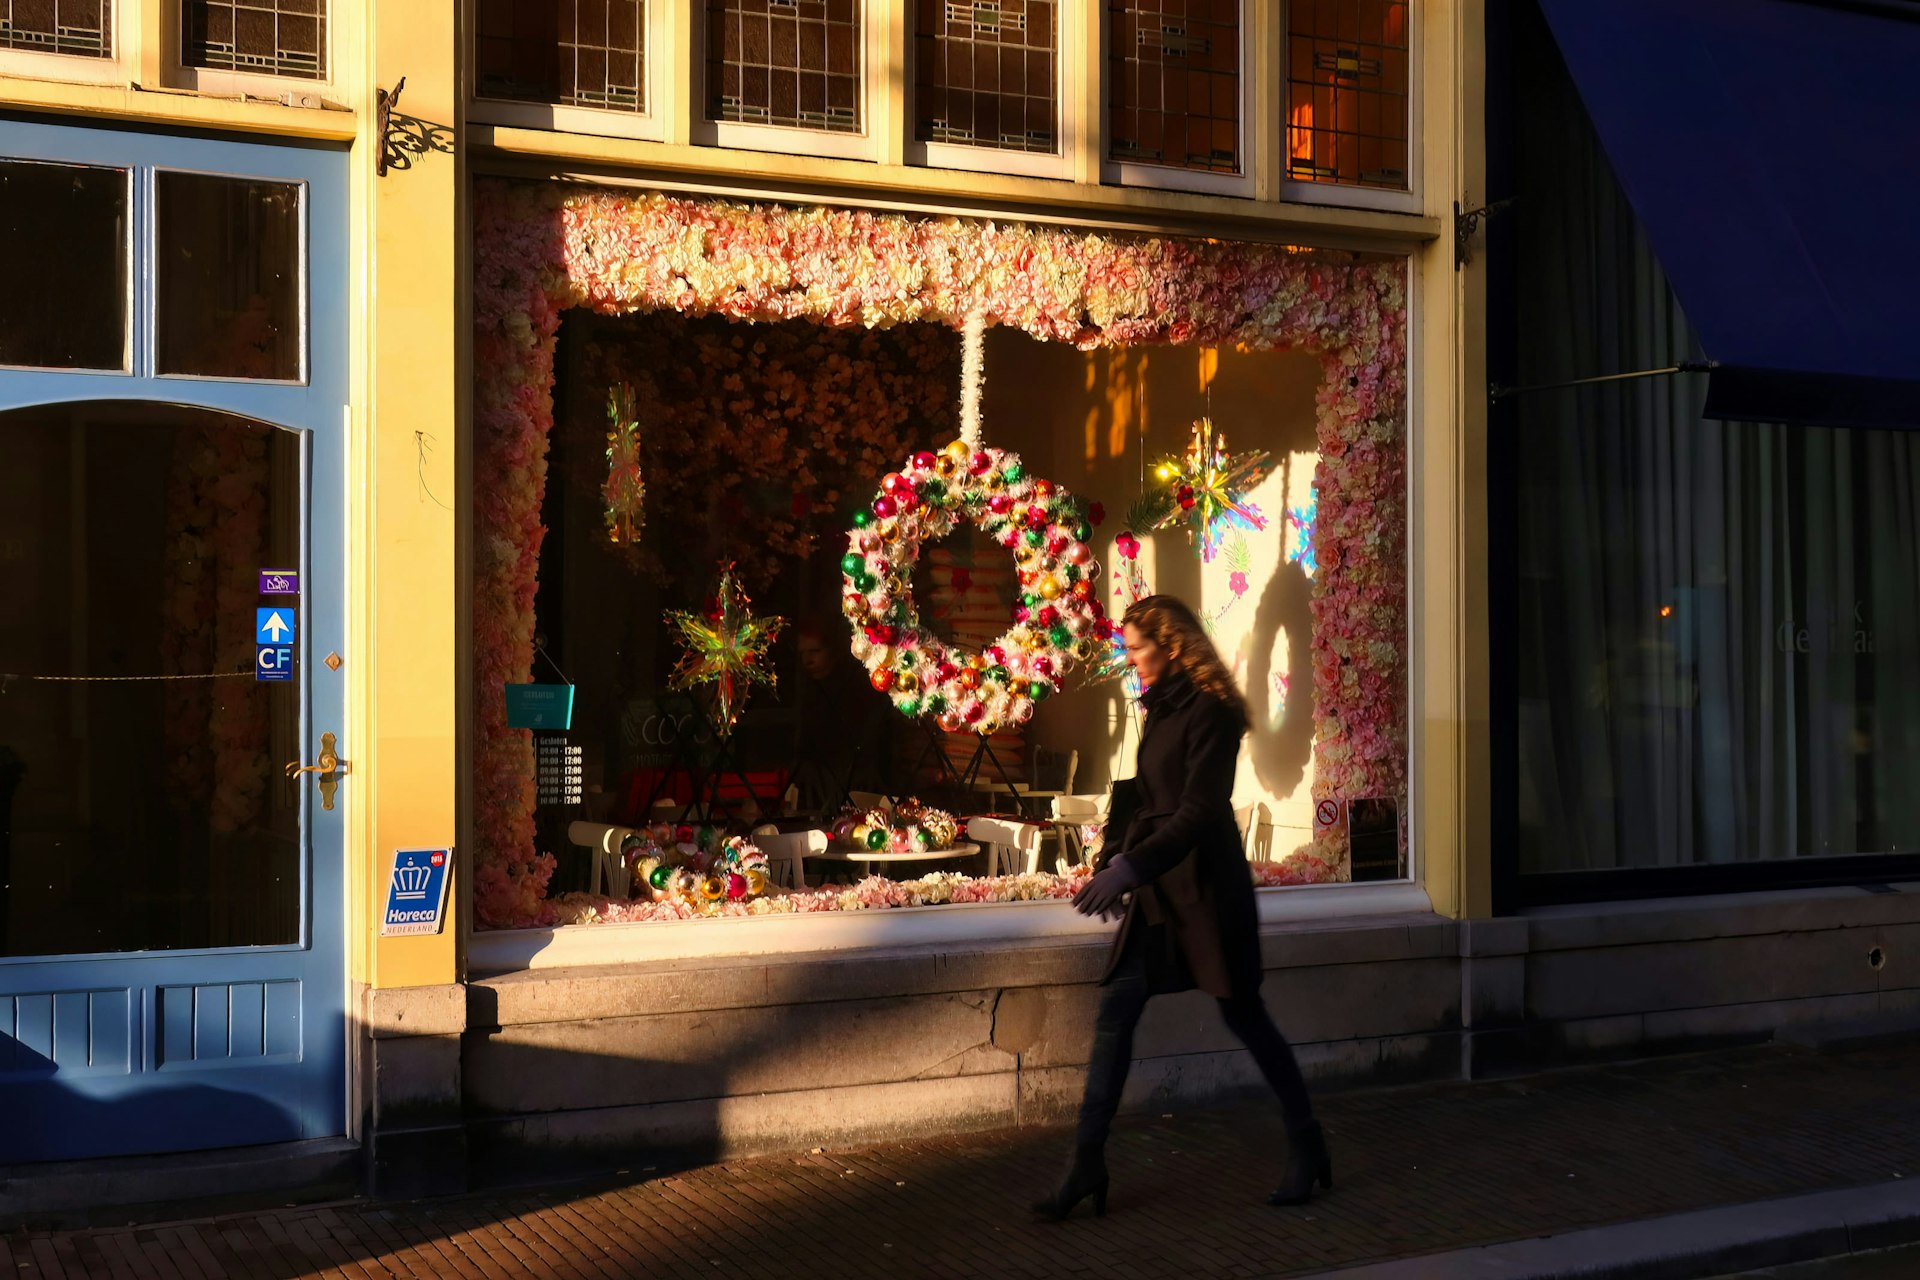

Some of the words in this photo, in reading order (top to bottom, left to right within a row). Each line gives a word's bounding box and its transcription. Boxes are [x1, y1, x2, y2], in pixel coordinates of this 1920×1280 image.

[258, 647, 291, 669] CF
[564, 746, 583, 755] 17:00
[564, 756, 583, 765] 17:00
[564, 766, 583, 775] 17:00
[564, 776, 583, 785] 17:00
[564, 786, 583, 795] 17:00
[563, 796, 582, 805] 17:00
[388, 909, 435, 923] Horeca
[386, 926, 433, 934] NEDERLAND
